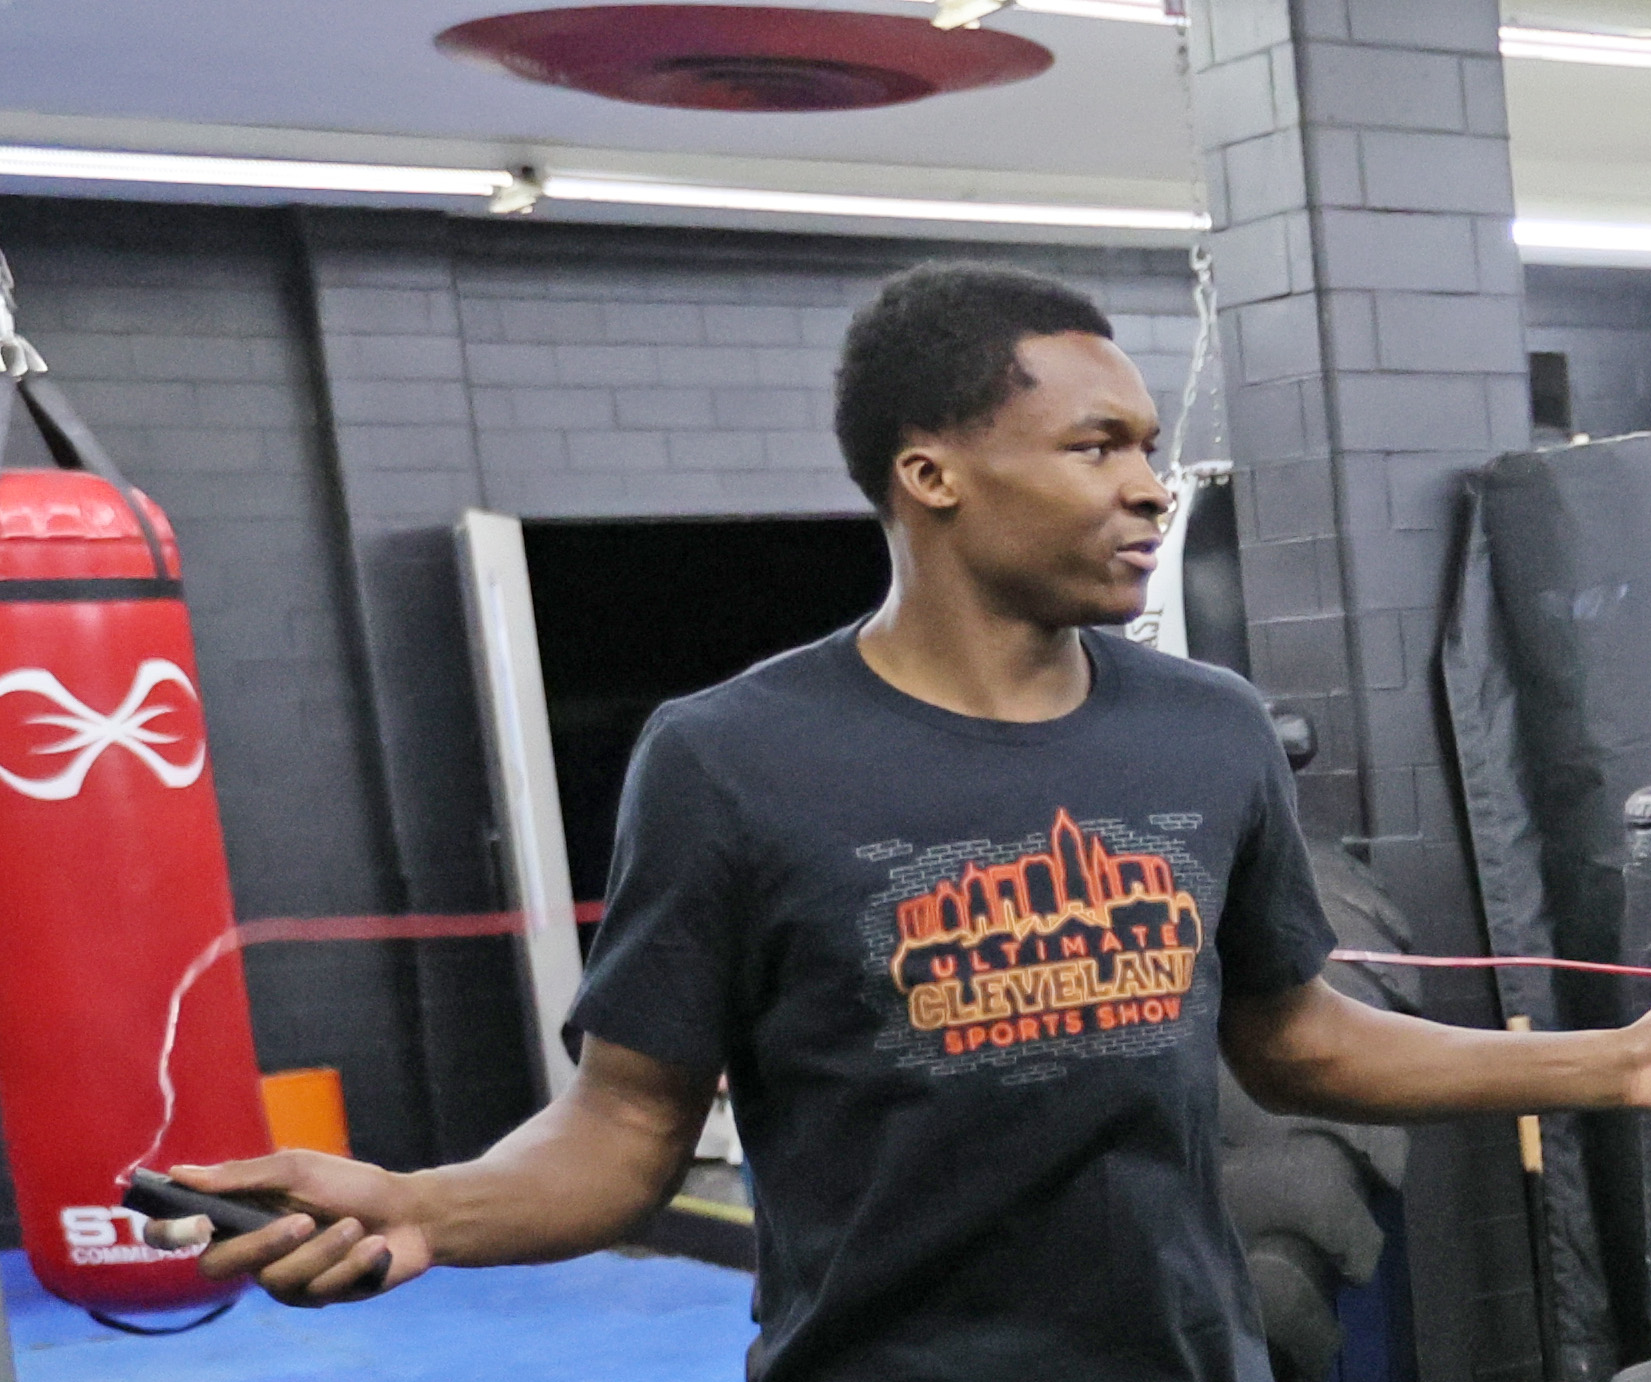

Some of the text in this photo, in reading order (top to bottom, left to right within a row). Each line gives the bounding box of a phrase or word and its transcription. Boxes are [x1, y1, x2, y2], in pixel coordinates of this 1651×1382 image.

[930, 922, 1180, 979] ULTIMATE
[942, 996, 1182, 1055] SPORTS SHOW
